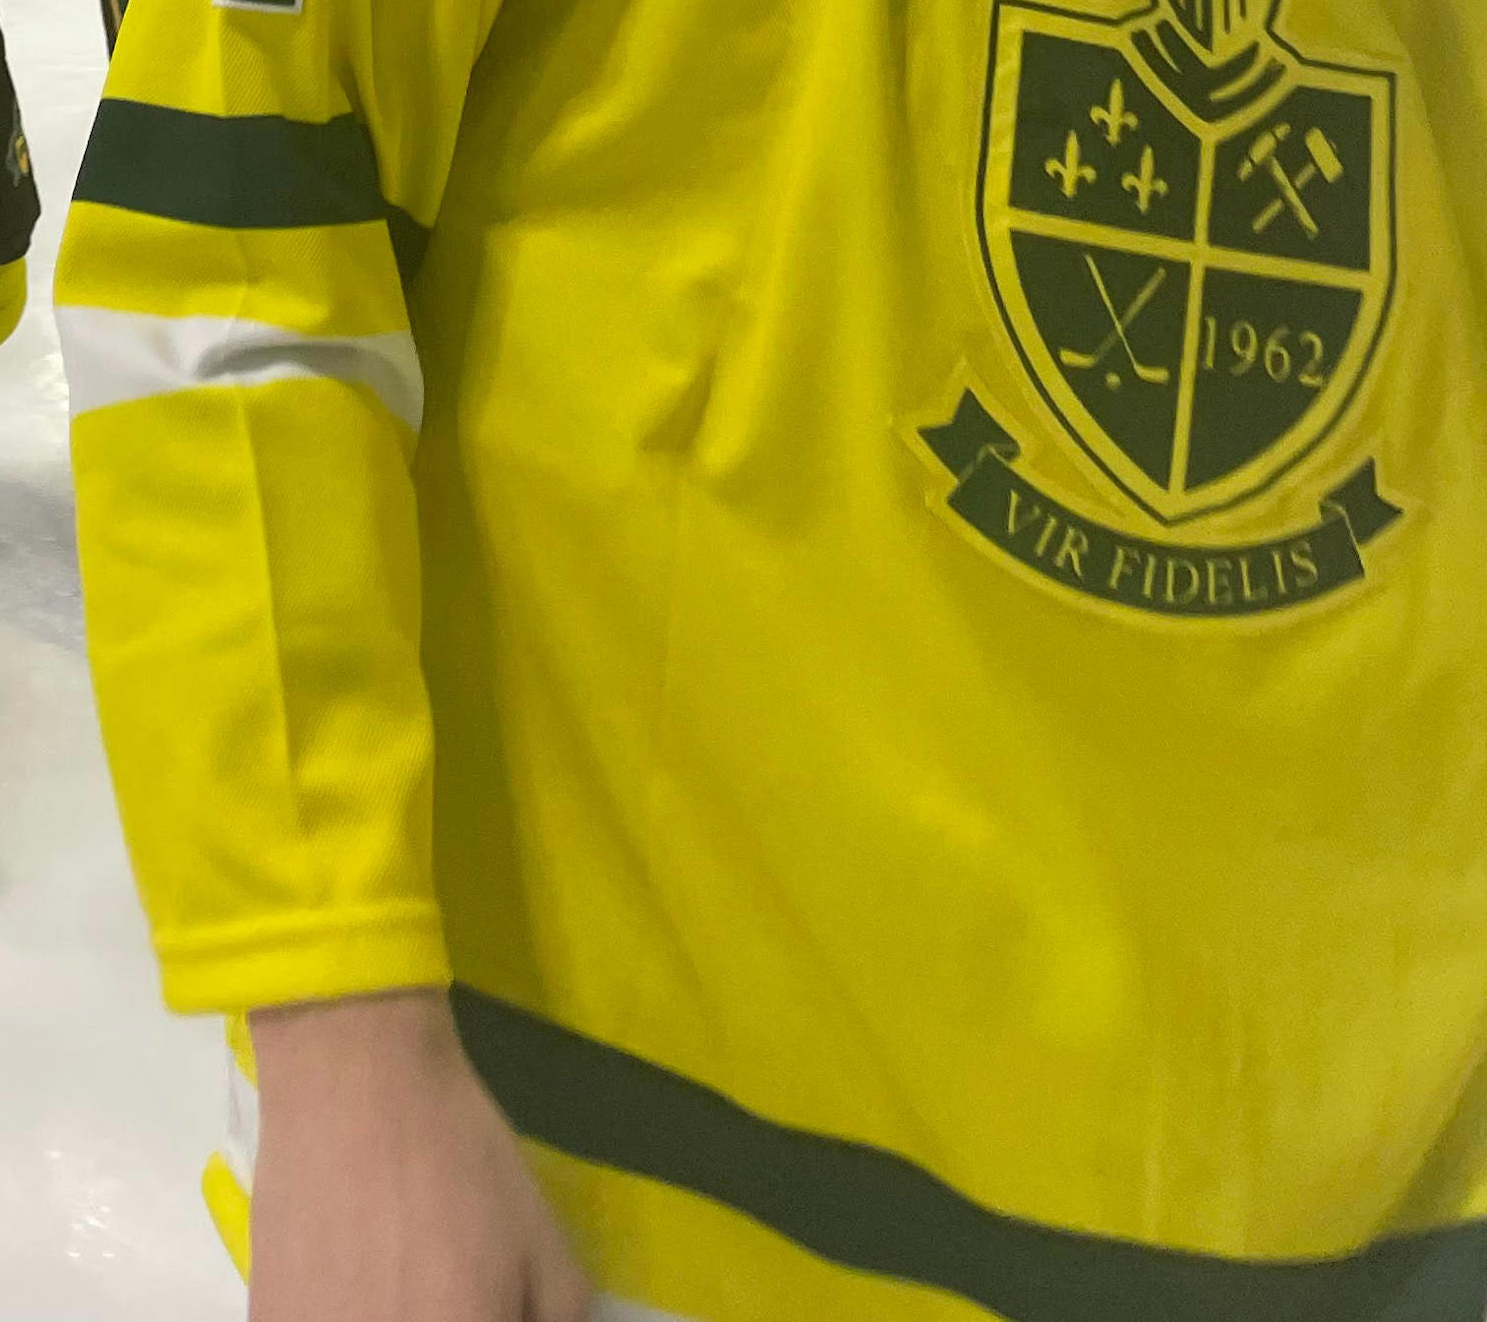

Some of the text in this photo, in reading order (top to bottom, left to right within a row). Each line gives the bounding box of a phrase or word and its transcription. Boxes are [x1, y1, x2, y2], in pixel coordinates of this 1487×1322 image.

[1204, 315, 1325, 389] 1962
[1007, 488, 1318, 606] VIR FIDELIS
